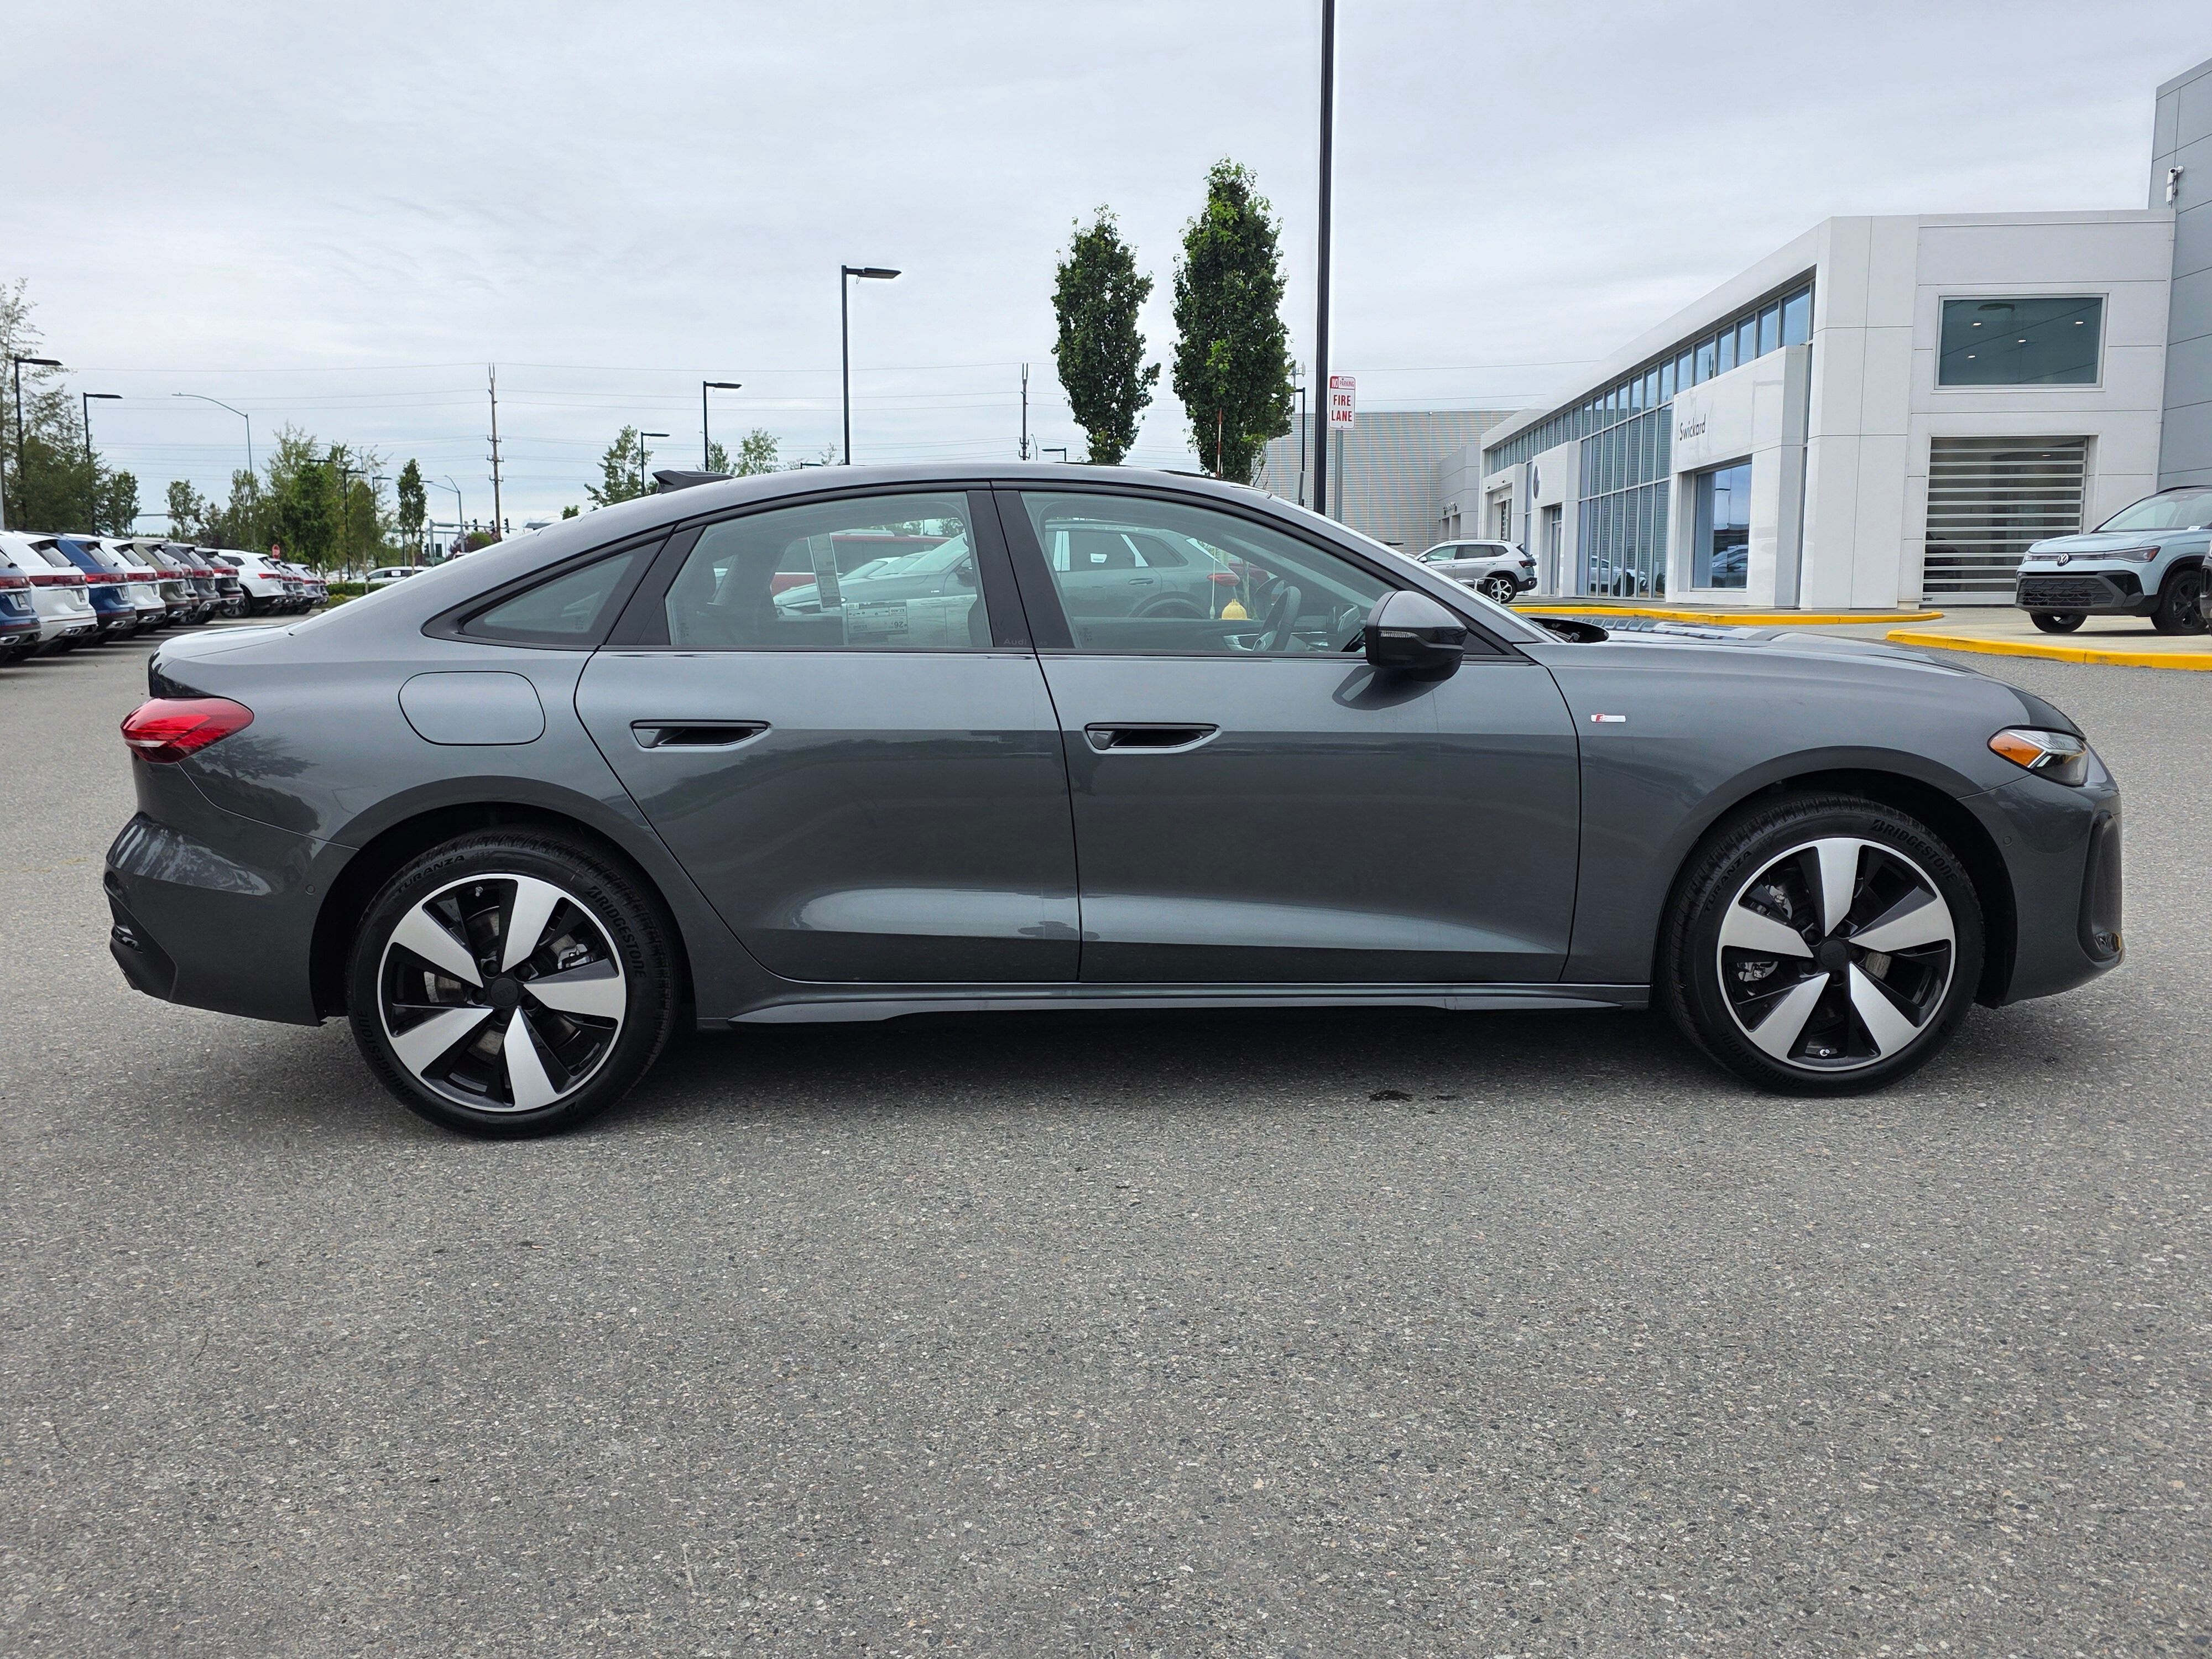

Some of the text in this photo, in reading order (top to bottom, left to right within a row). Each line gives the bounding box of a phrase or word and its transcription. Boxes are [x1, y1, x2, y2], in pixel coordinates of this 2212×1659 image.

[1332, 378, 1338, 388] NO
[1331, 410, 1353, 422] LANE
[1333, 394, 1351, 406] FIRE
[1679, 413, 1706, 441] Swickard
[1870, 819, 1958, 881] BRIDGESTONE
[395, 855, 465, 894] TURANZA
[1704, 851, 1752, 912] TURANZA
[585, 885, 646, 978] BRIDGESTONE
